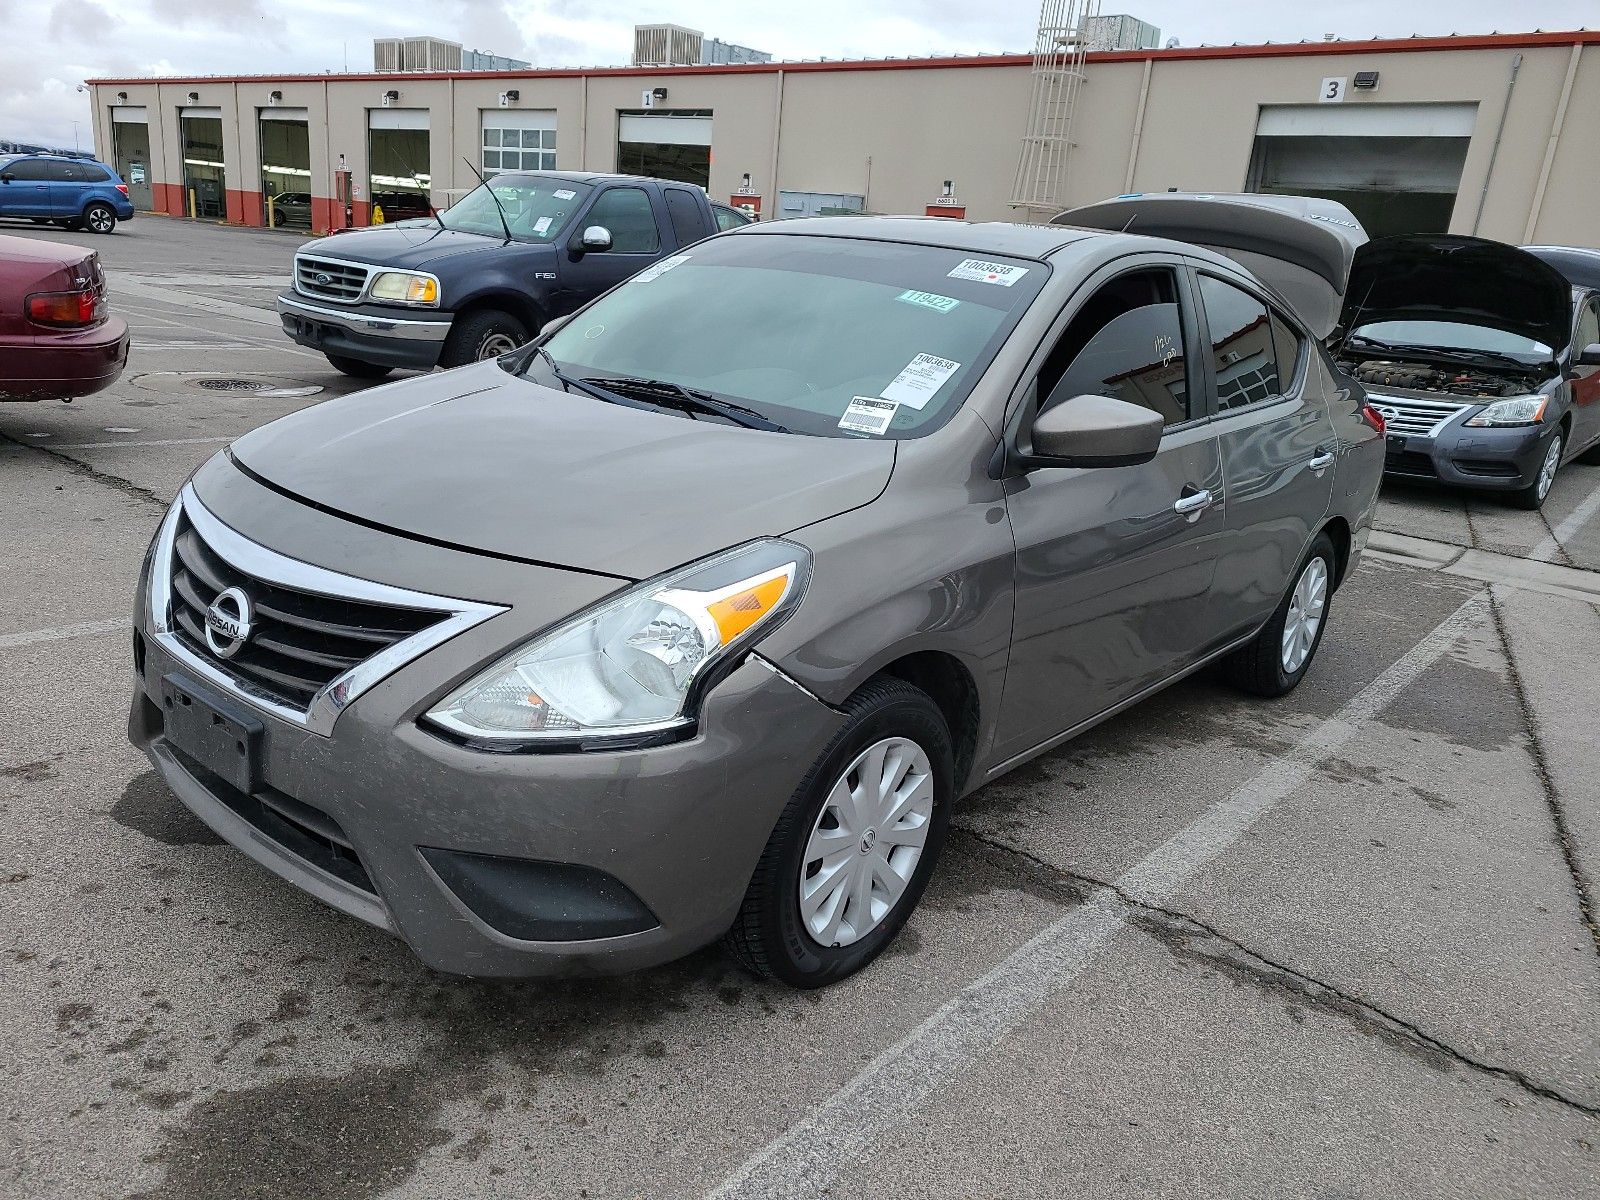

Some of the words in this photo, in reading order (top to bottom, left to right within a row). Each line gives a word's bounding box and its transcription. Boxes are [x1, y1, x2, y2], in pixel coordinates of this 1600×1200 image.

[1326, 81, 1339, 99] 3
[501, 94, 507, 106] 2
[645, 93, 651, 106] 1
[962, 260, 1014, 276] 1003638
[916, 354, 955, 370] 1003638
